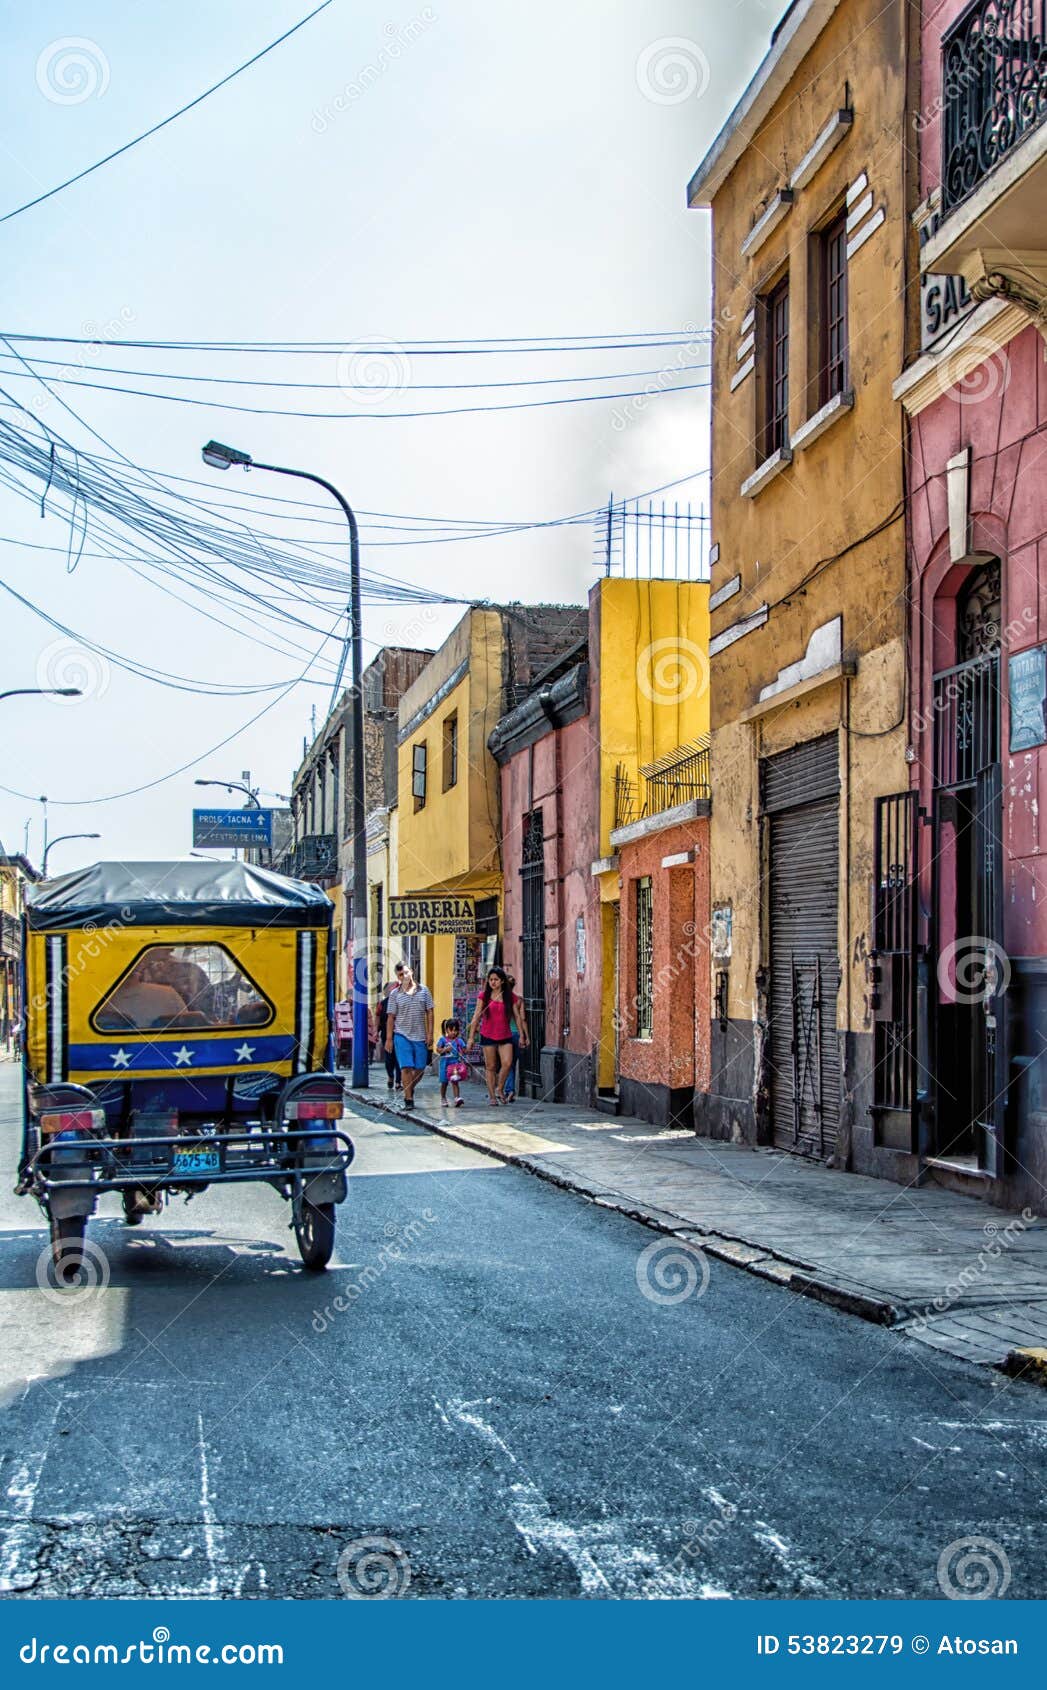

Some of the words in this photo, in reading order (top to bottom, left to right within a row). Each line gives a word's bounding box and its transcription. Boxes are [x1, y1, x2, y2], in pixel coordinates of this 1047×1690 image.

[228, 815, 252, 824] TACNA
[241, 833, 250, 842] DE
[390, 901, 473, 919] LIBRERIA
[391, 920, 437, 935] COPIAS
